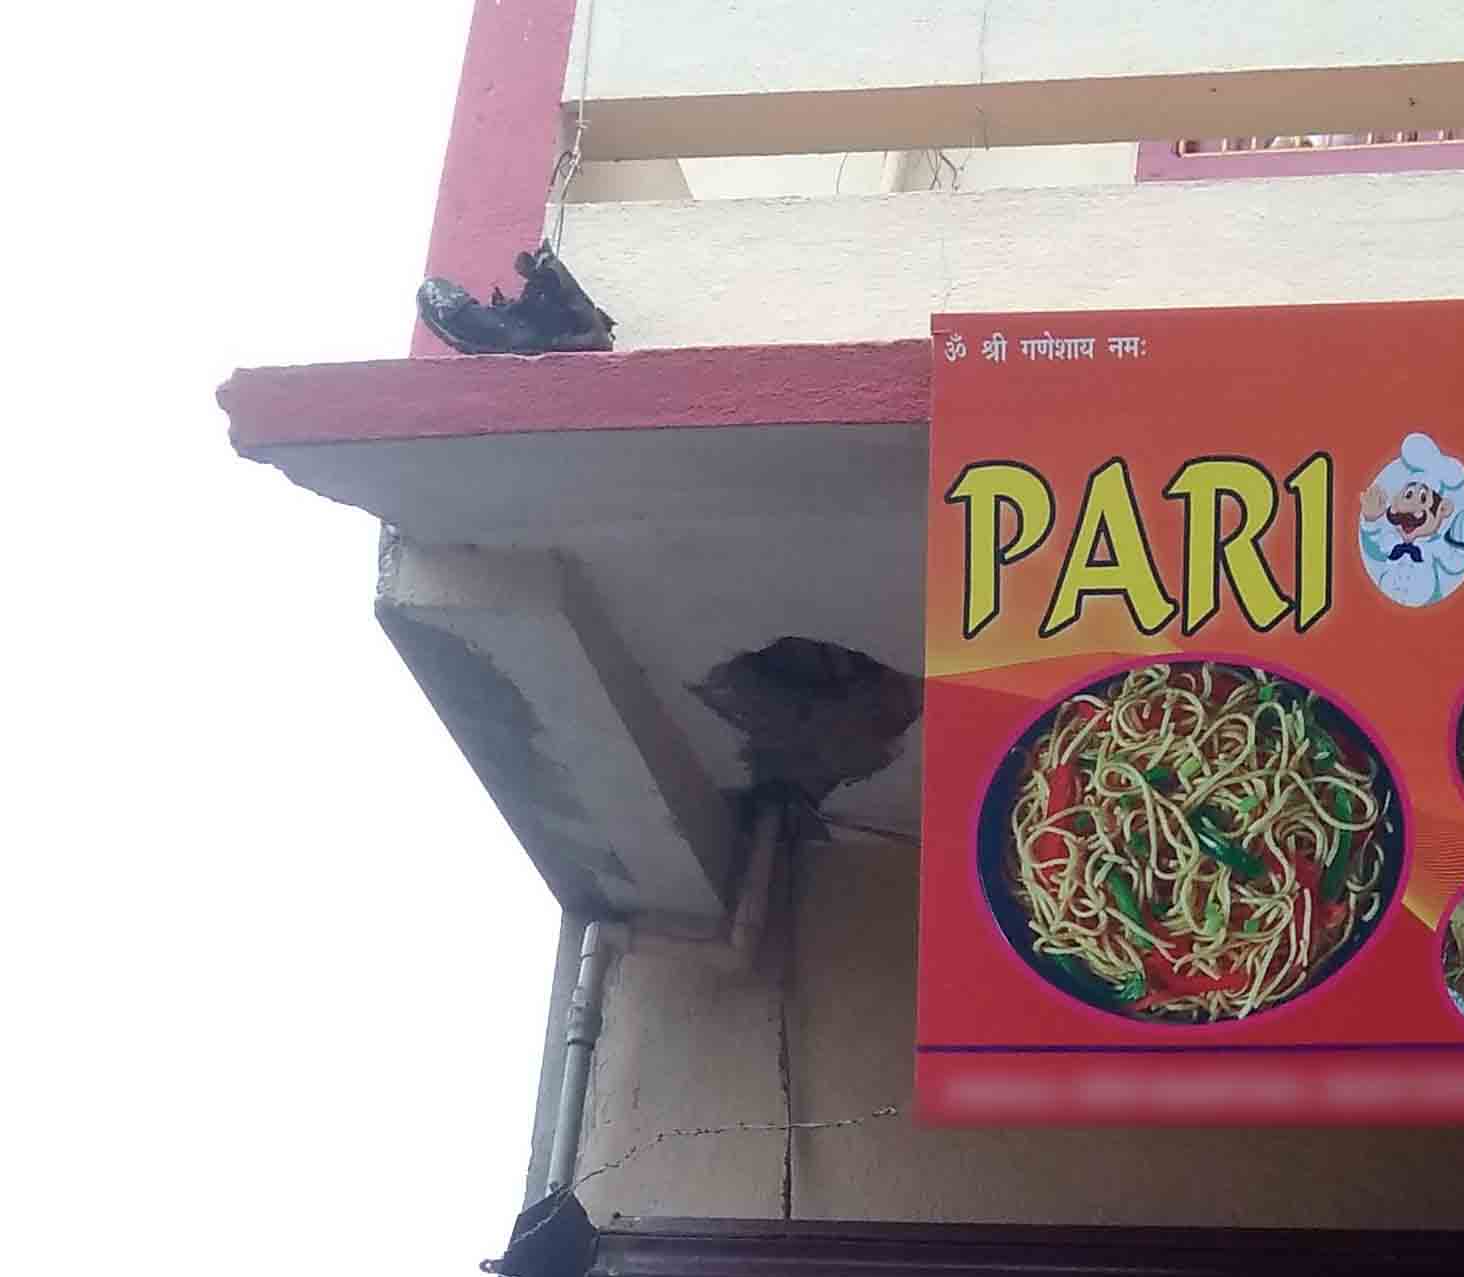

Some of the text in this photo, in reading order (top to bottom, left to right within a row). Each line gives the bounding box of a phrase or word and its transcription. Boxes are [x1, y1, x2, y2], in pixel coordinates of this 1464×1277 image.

[981, 332, 1008, 363] श्री
[1019, 331, 1095, 361] गणेशाय
[1107, 335, 1148, 359] नमः
[945, 450, 1334, 639] PARI
